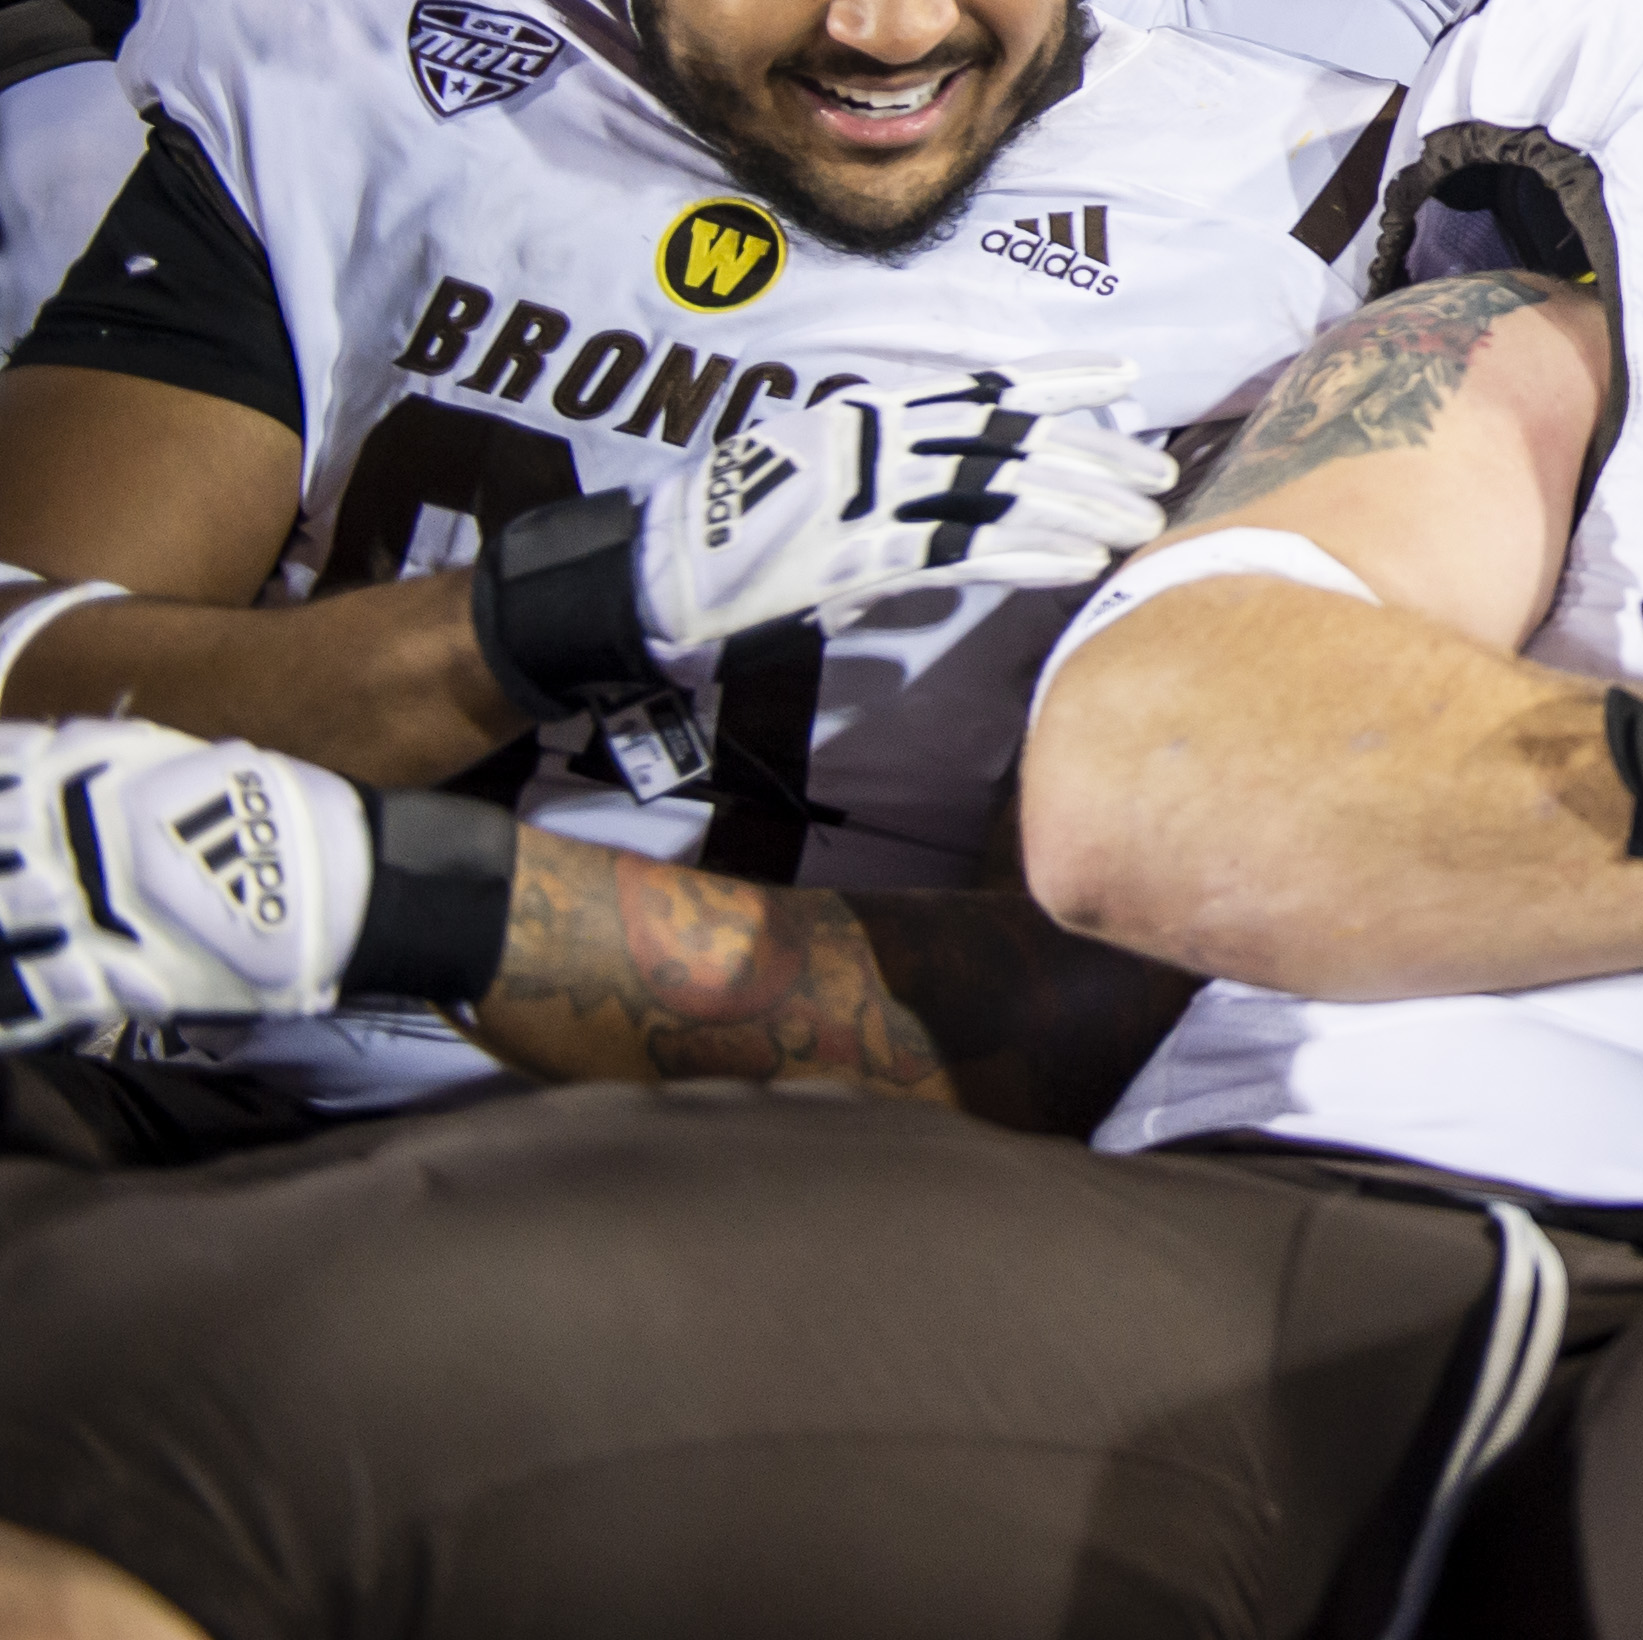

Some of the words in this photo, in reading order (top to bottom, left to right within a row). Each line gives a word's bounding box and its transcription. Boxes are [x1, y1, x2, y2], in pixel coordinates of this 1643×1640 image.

[410, 28, 544, 84] MAC
[684, 219, 772, 297] W
[980, 223, 1120, 298] adidas
[228, 767, 290, 930] adidas
